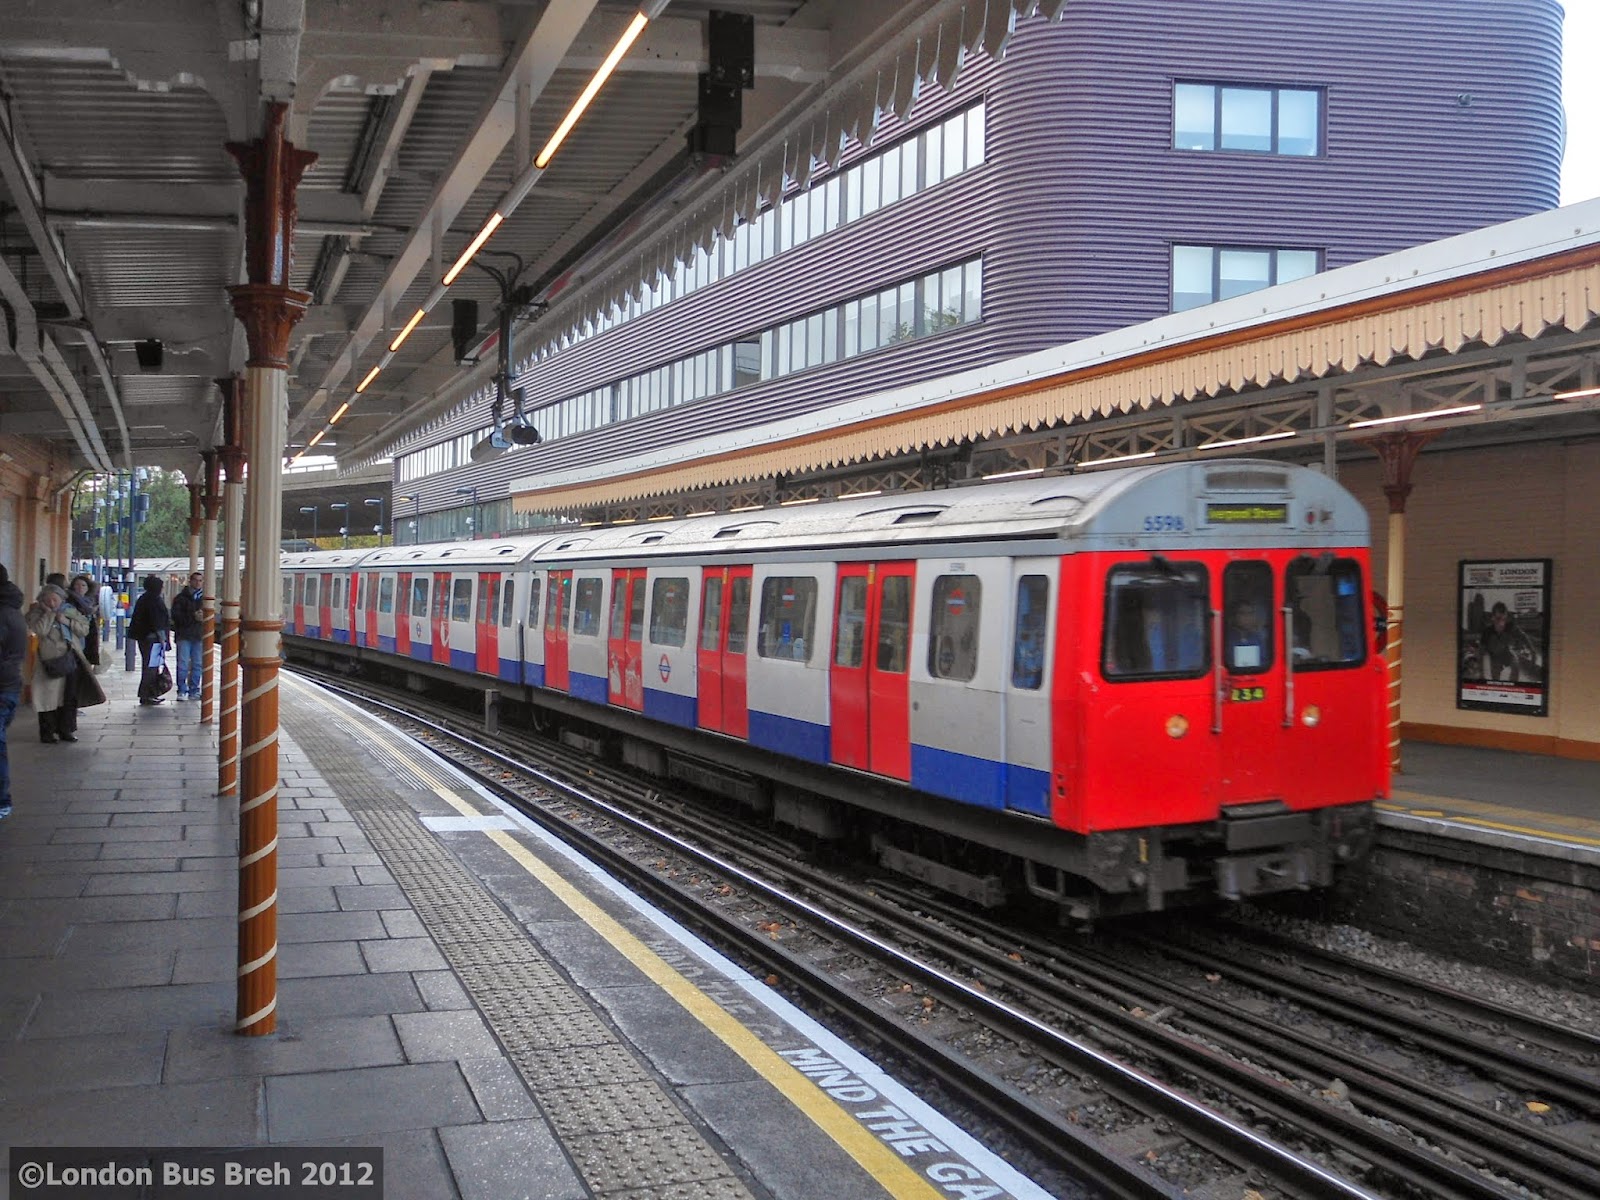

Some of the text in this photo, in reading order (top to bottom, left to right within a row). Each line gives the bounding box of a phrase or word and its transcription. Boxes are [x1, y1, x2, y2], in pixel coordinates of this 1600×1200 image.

[1500, 568, 1538, 576] LONDON
[777, 1048, 877, 1102] MIND
[855, 1104, 950, 1157] THE
